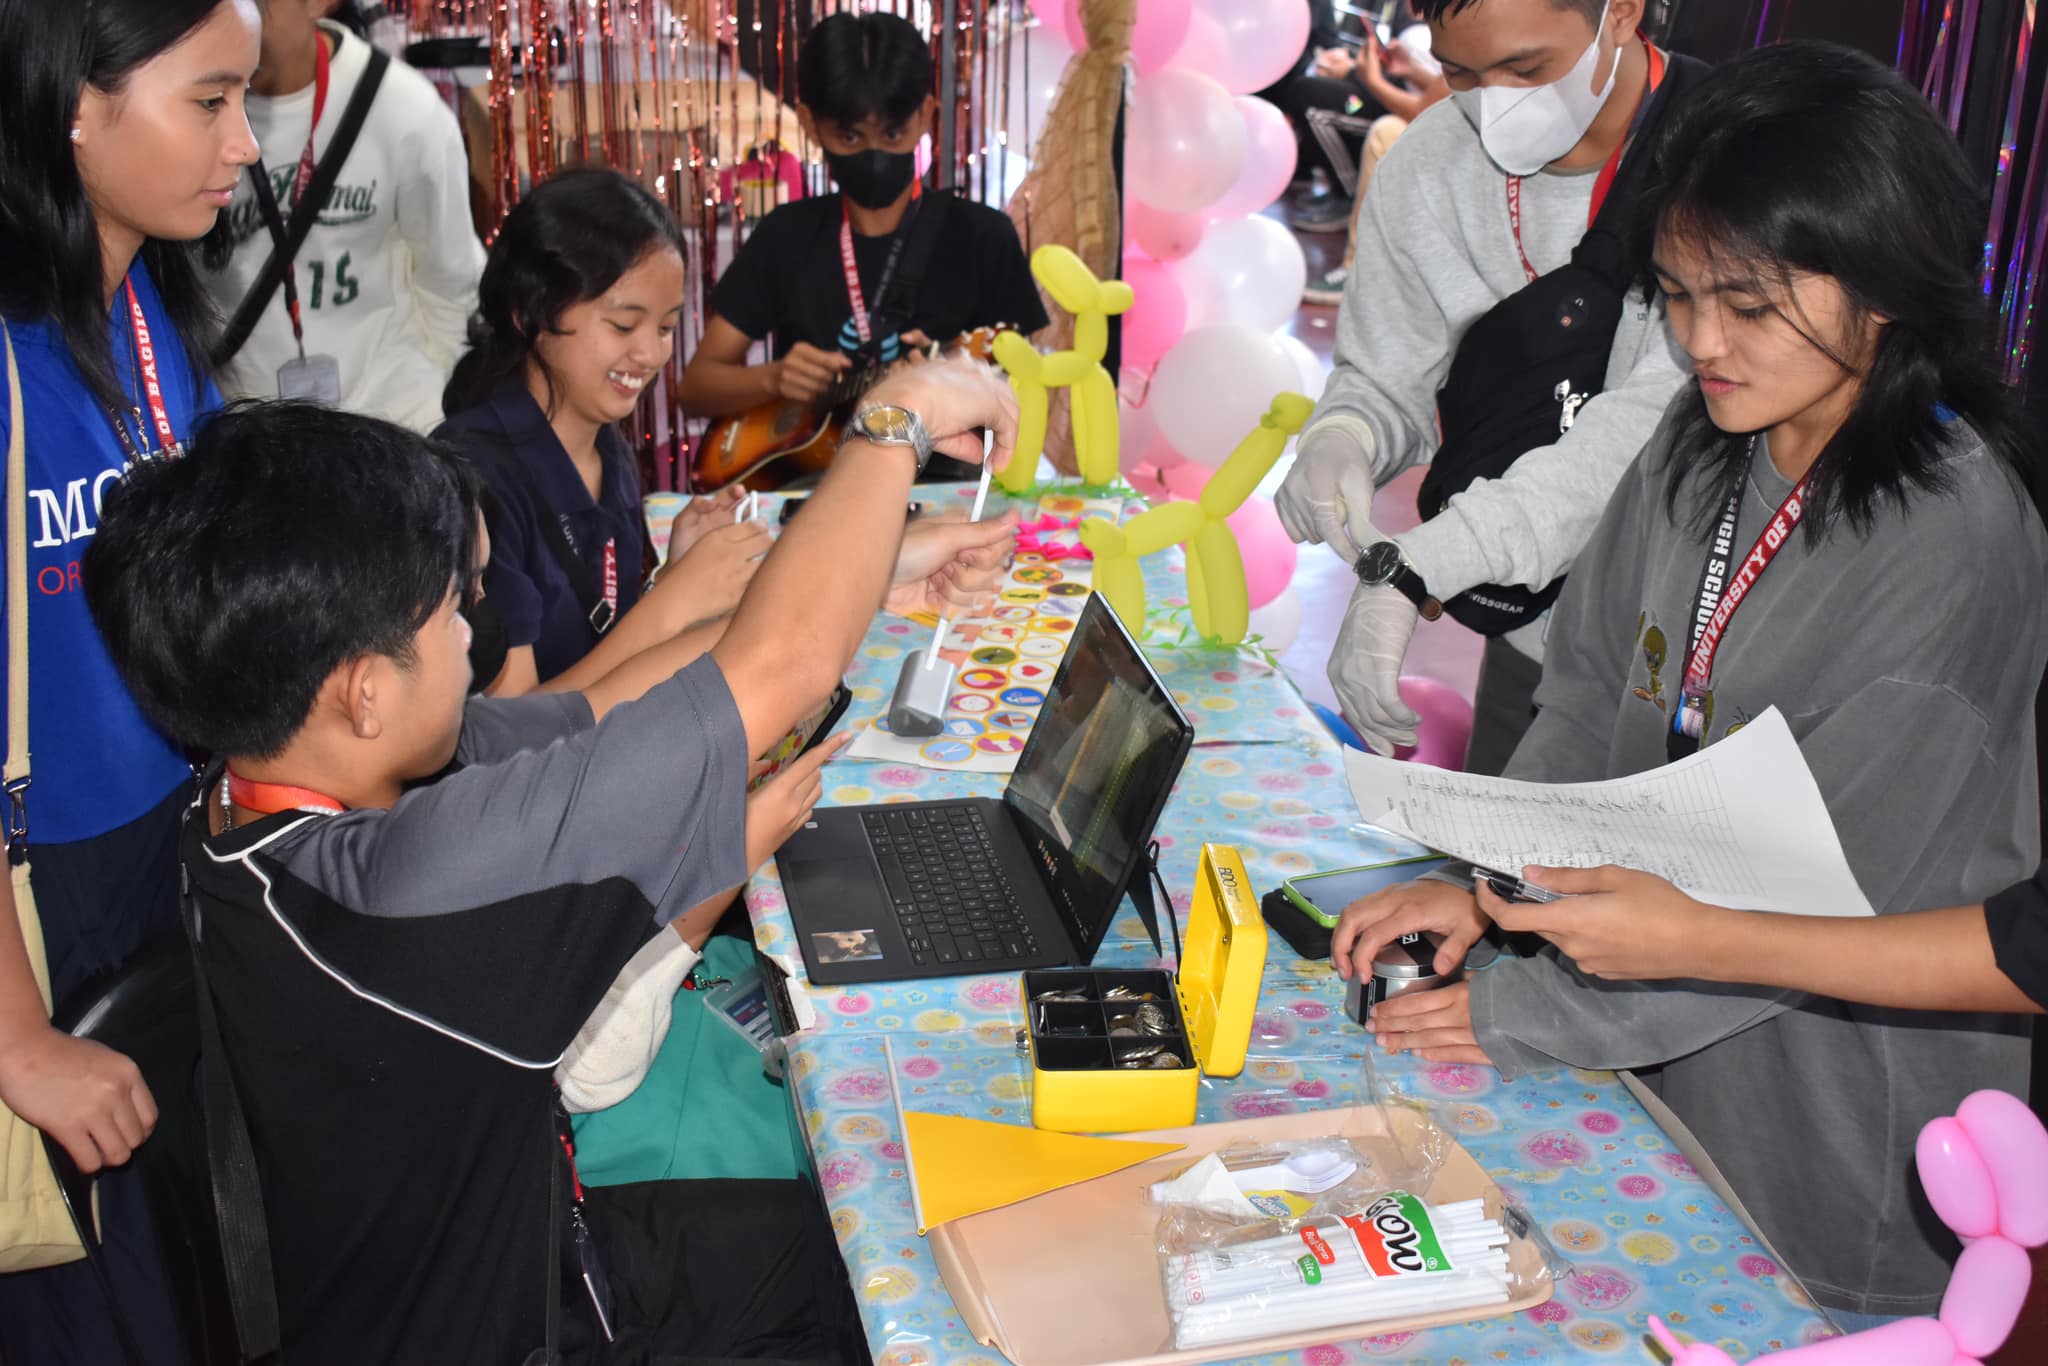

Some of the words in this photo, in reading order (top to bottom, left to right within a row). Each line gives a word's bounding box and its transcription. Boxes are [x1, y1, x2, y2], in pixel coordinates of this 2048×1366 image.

[308, 251, 359, 309] 15
[132, 302, 162, 397] BAGUIO
[152, 405, 172, 436] OF
[1691, 543, 1767, 676] UNIVERSITY
[1764, 515, 1788, 550] OF
